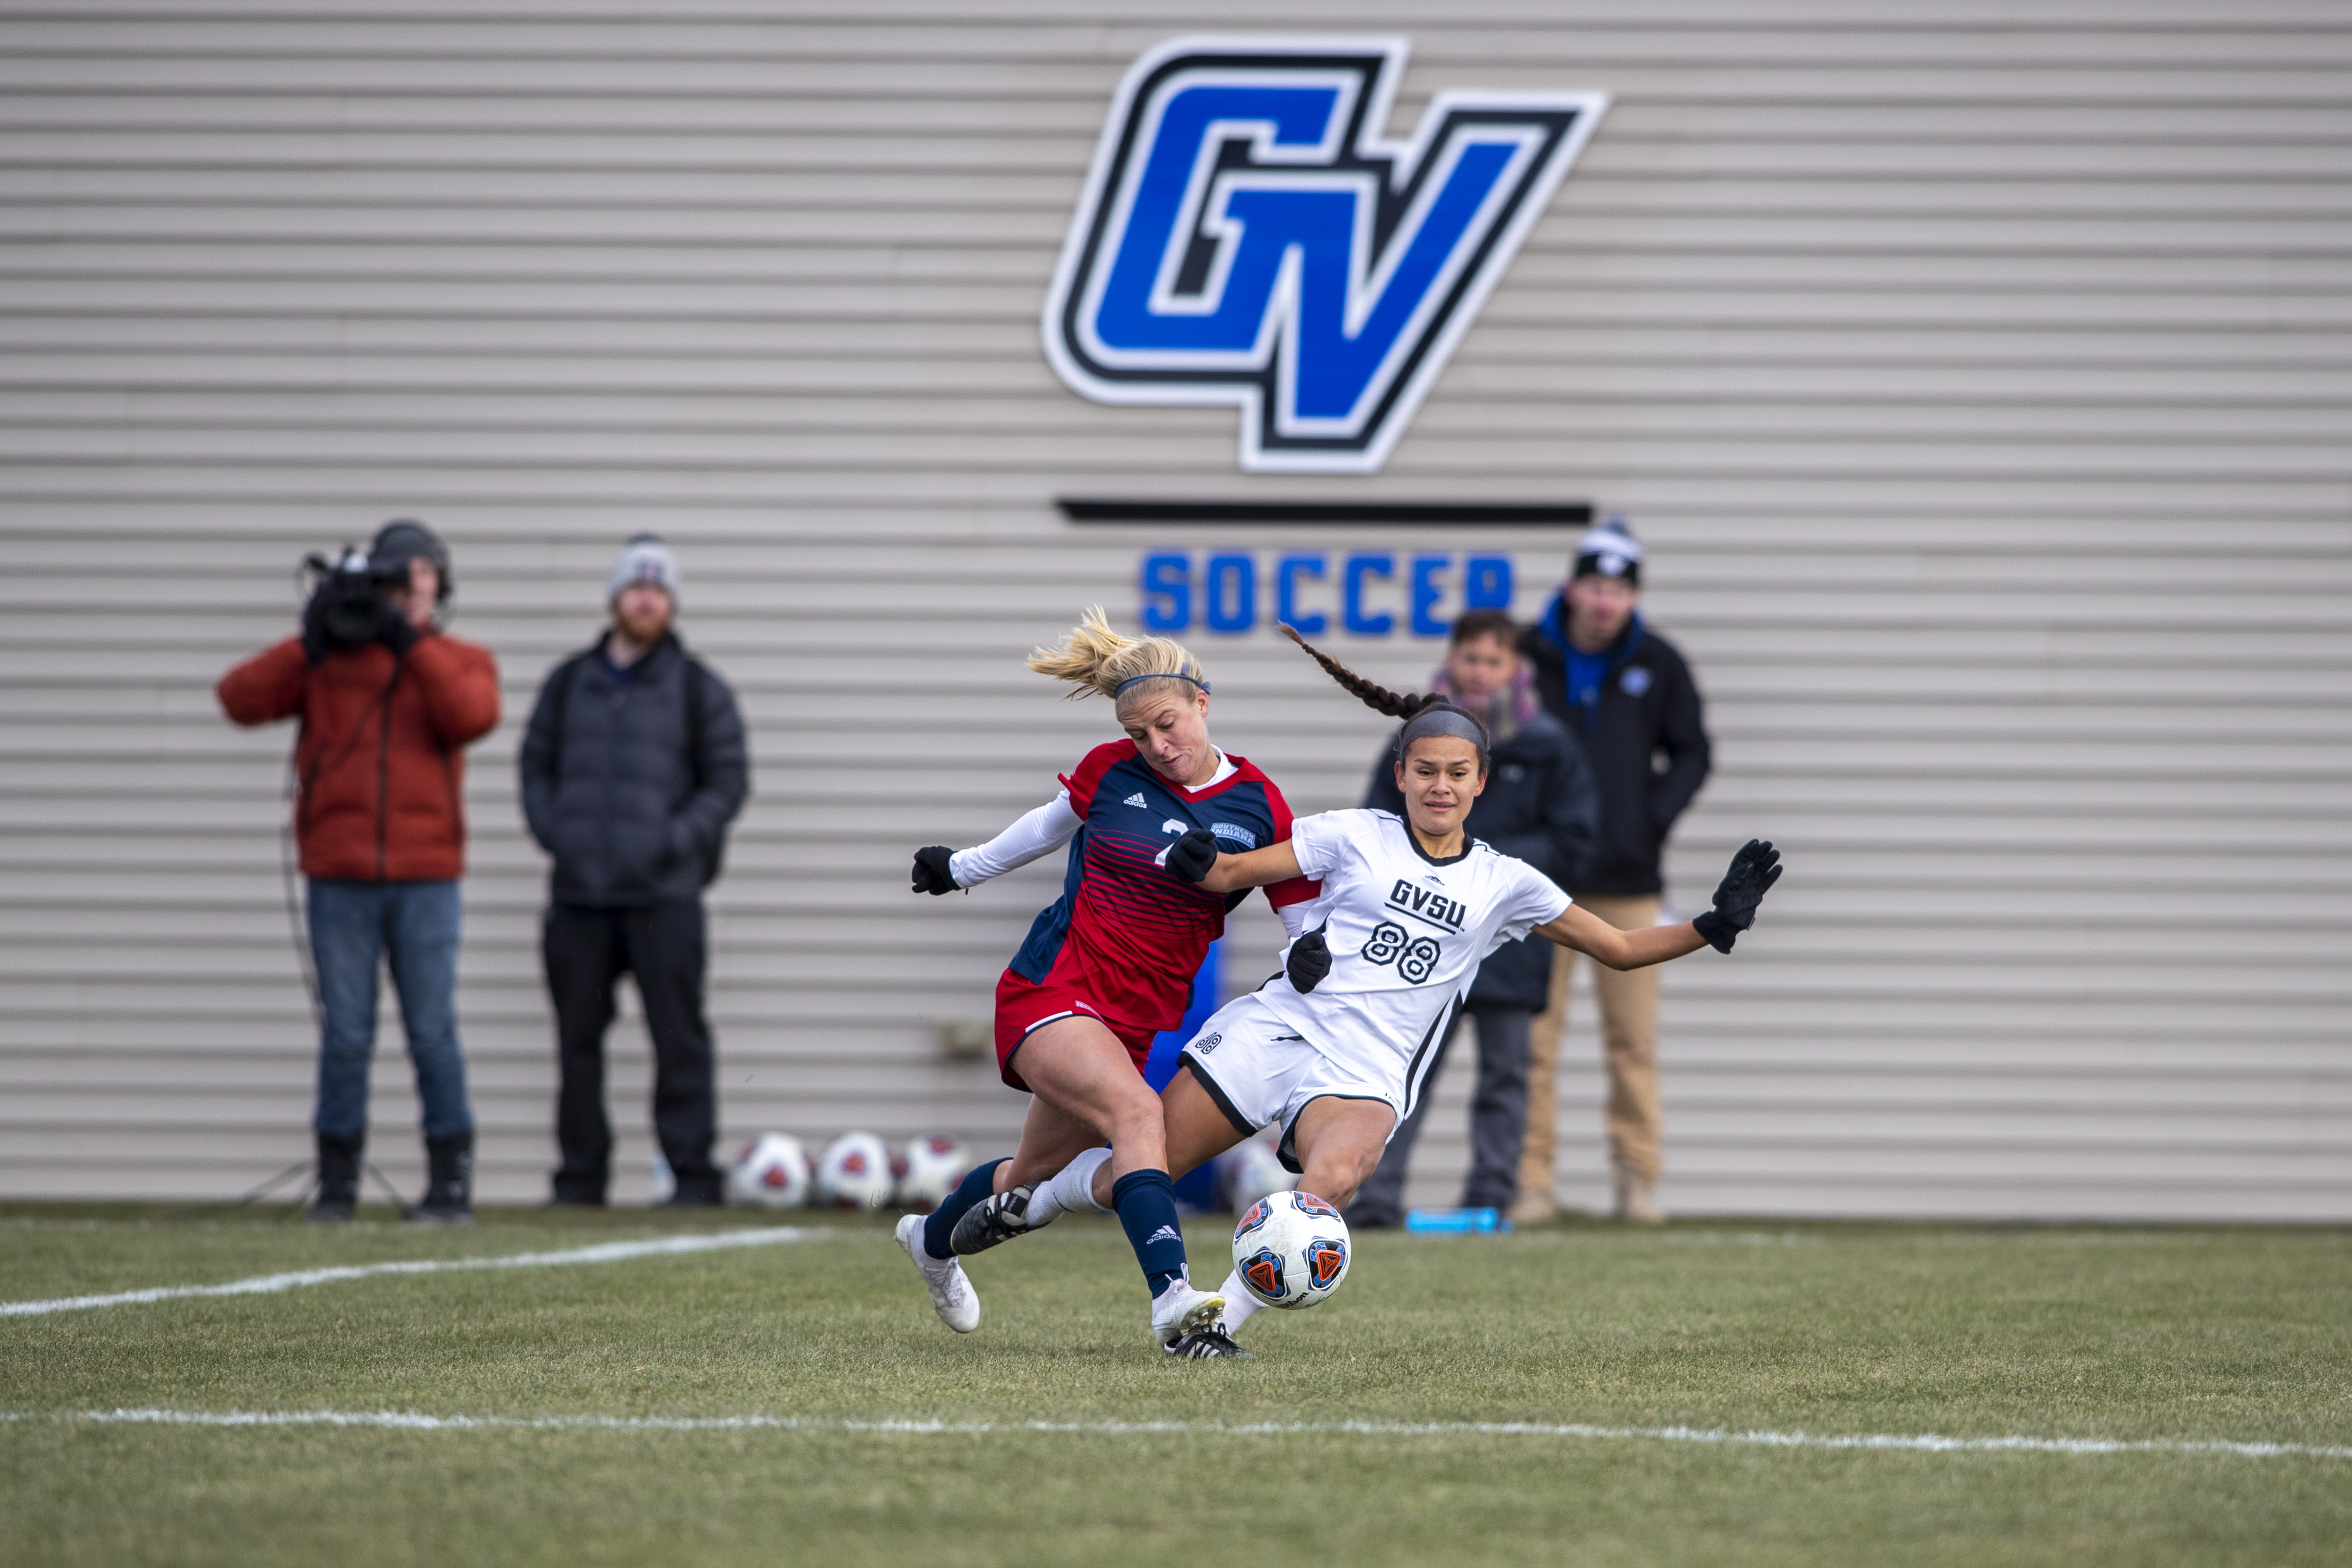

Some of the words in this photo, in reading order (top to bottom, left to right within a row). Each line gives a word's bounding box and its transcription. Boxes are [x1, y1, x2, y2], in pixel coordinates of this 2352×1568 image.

[1041, 35, 1611, 473] GV
[1145, 553, 1511, 634] SOCCER
[1123, 798, 1147, 809] adidas
[1211, 828, 1254, 846] INDIANA
[1213, 823, 1254, 840] SOUTHERN
[1390, 879, 1466, 929] GVSU
[1360, 921, 1441, 985] 88
[1195, 1032, 1222, 1055] 88
[1146, 1233, 1181, 1244] adidas
